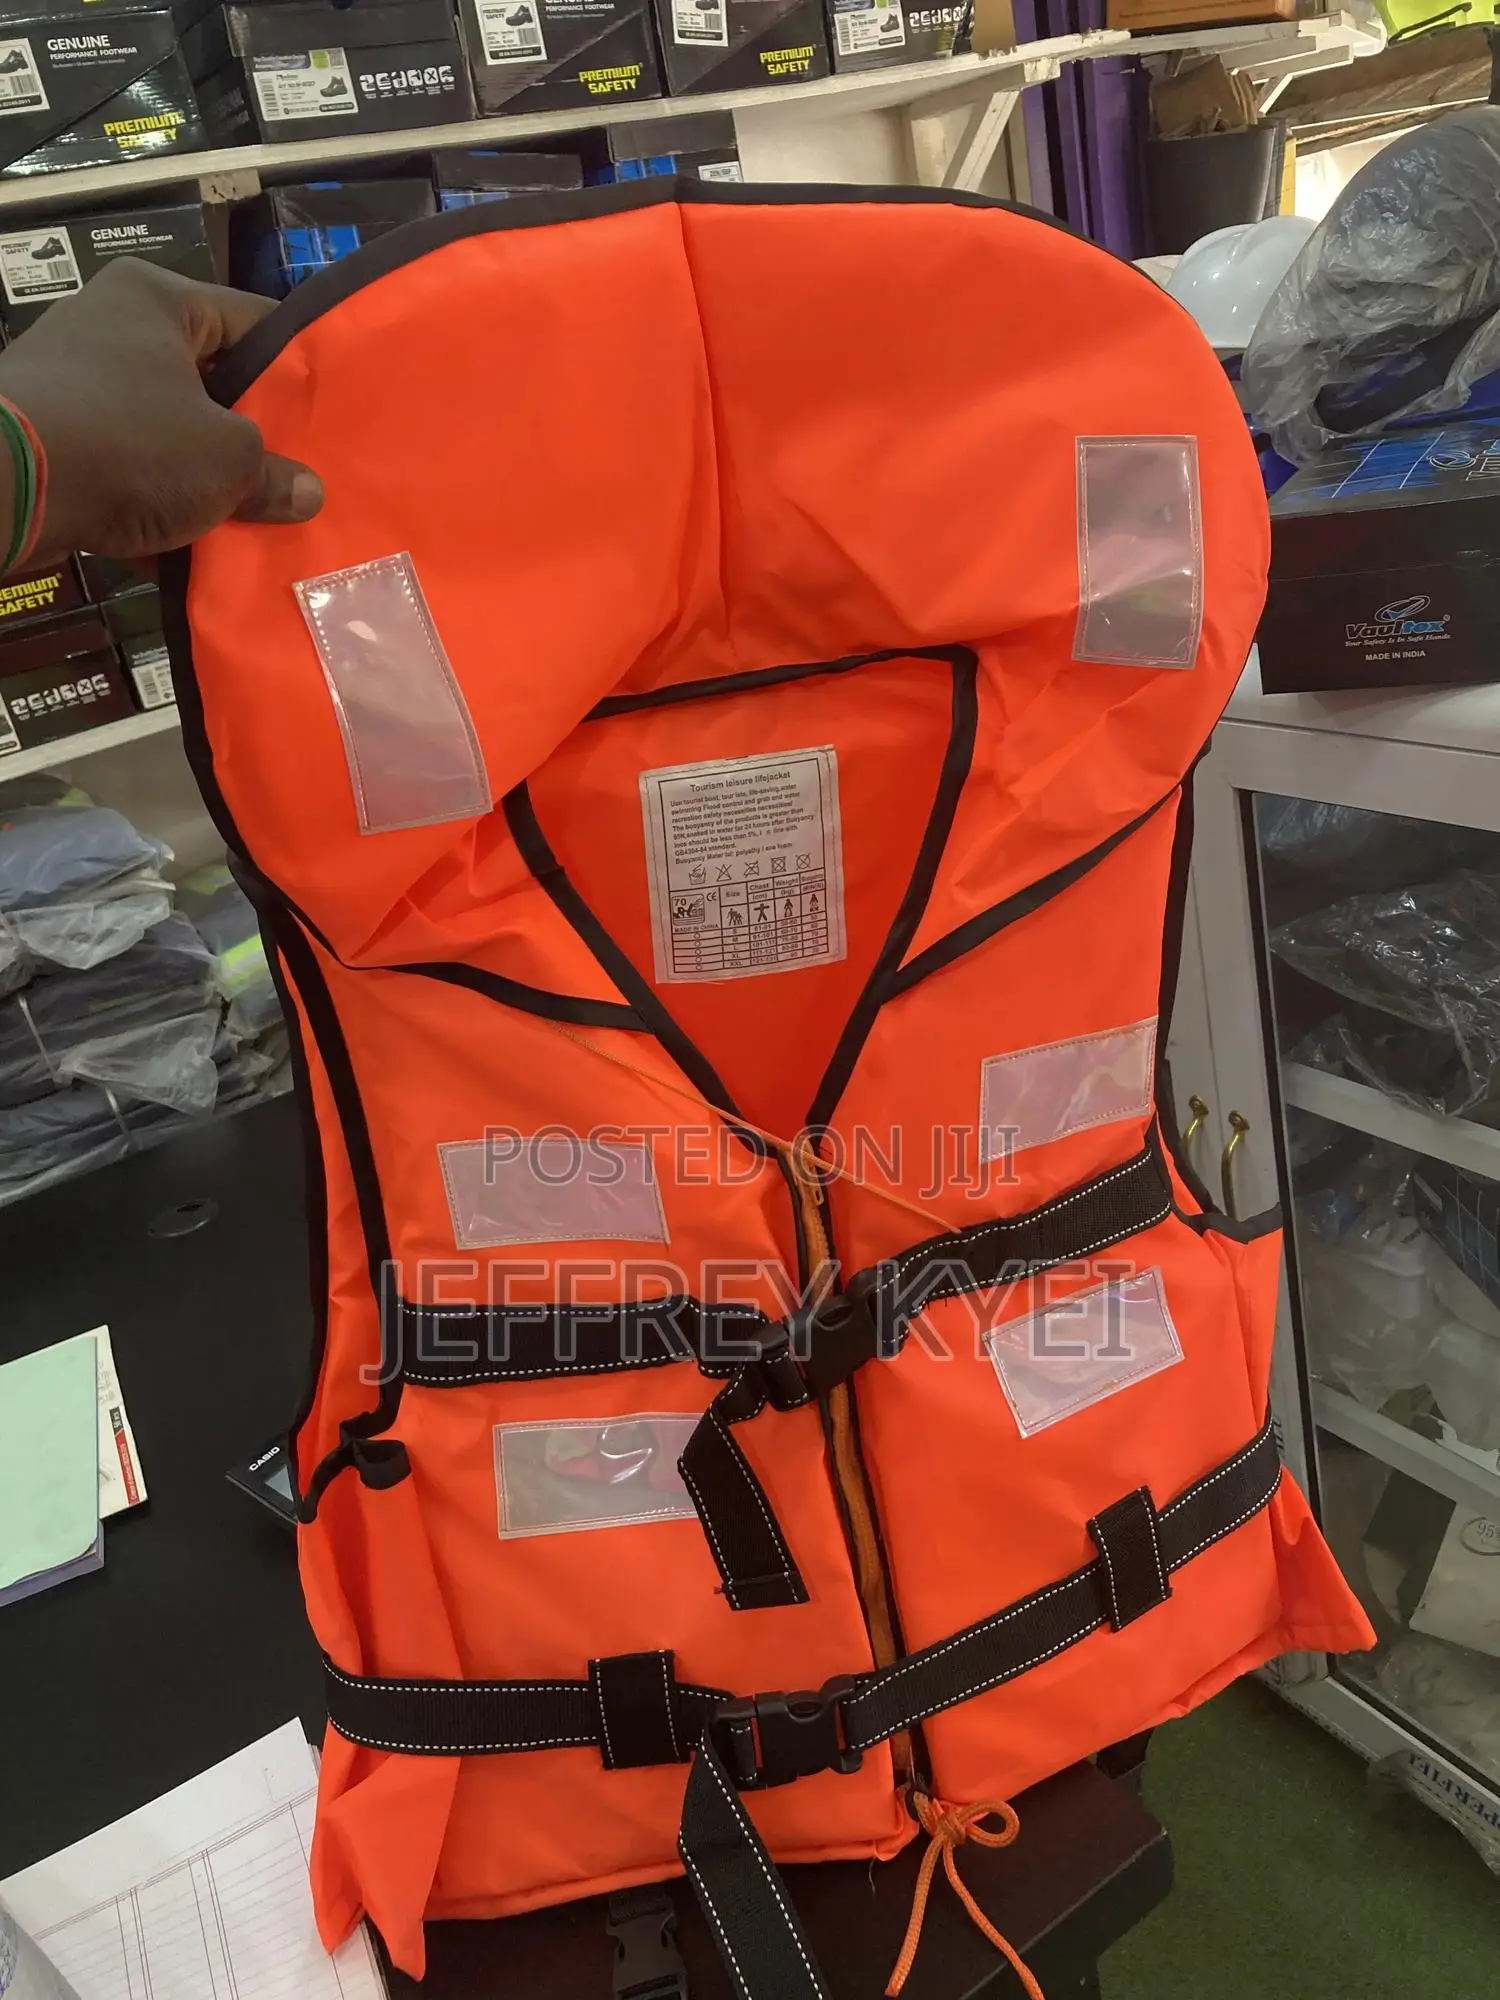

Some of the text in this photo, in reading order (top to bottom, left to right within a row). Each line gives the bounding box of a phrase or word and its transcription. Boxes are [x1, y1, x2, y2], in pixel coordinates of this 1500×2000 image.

[47, 35, 110, 51] GENUINE
[50, 47, 138, 60] PERFORMANCE FOOTWEAR
[760, 46, 814, 63] PREMIUM
[579, 64, 641, 82] PREMIUM
[767, 59, 810, 75] SAFETY
[588, 78, 637, 93] SAFETY
[103, 111, 181, 136] PREMIUM
[91, 225, 149, 240] GENUINE
[93, 235, 173, 249] PERFORMANCE FOOTWEAR
[0, 576, 59, 600] EMIUM
[1345, 619, 1445, 640] Vaultex
[1366, 650, 1426, 661] MADE IN INDIA
[690, 771, 791, 793] Tourism leisure lifejacket
[749, 882, 769, 890] Chest
[674, 897, 686, 906] 70
[249, 1446, 280, 1472] CASIO
